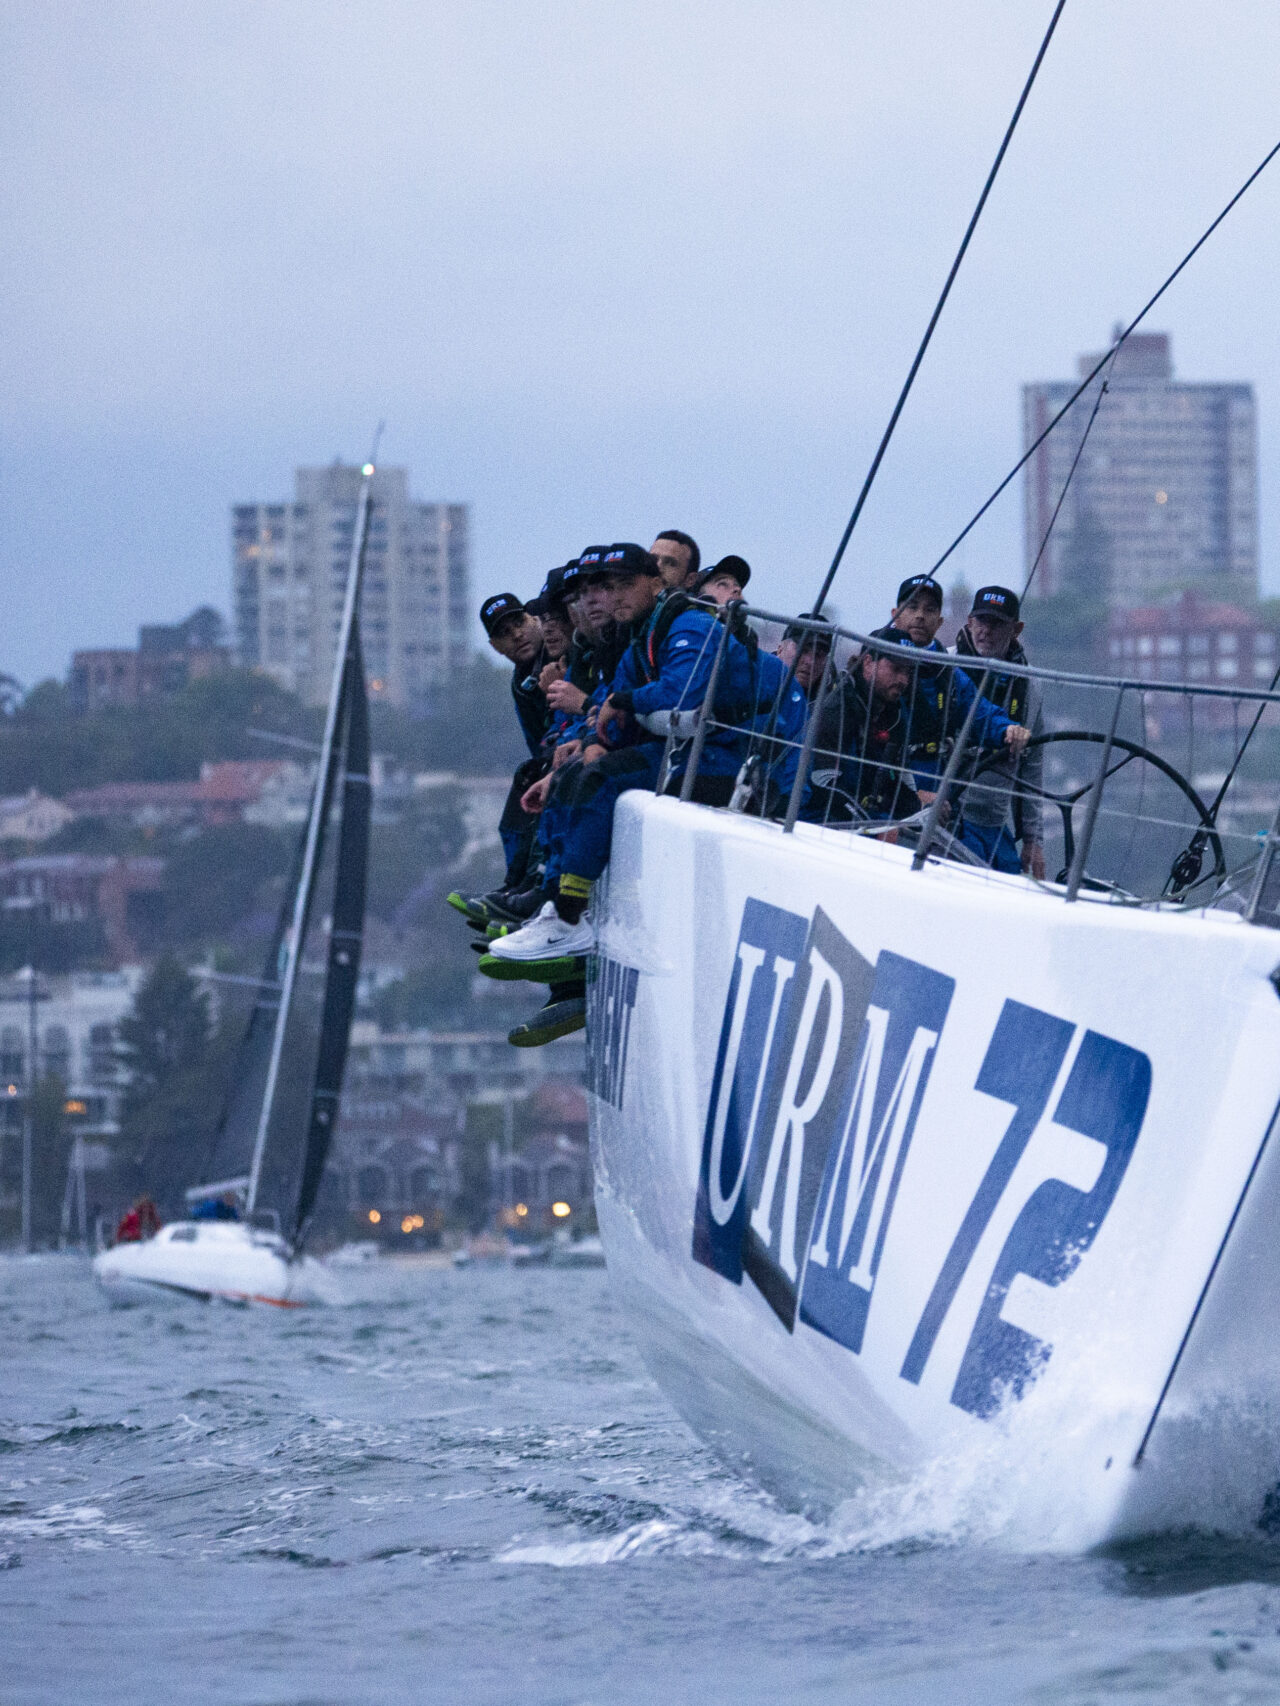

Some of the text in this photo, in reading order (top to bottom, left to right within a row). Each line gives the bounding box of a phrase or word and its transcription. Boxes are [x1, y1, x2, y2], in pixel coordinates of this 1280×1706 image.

[983, 593, 1006, 604] URM
[706, 938, 1153, 1420] URM 72
